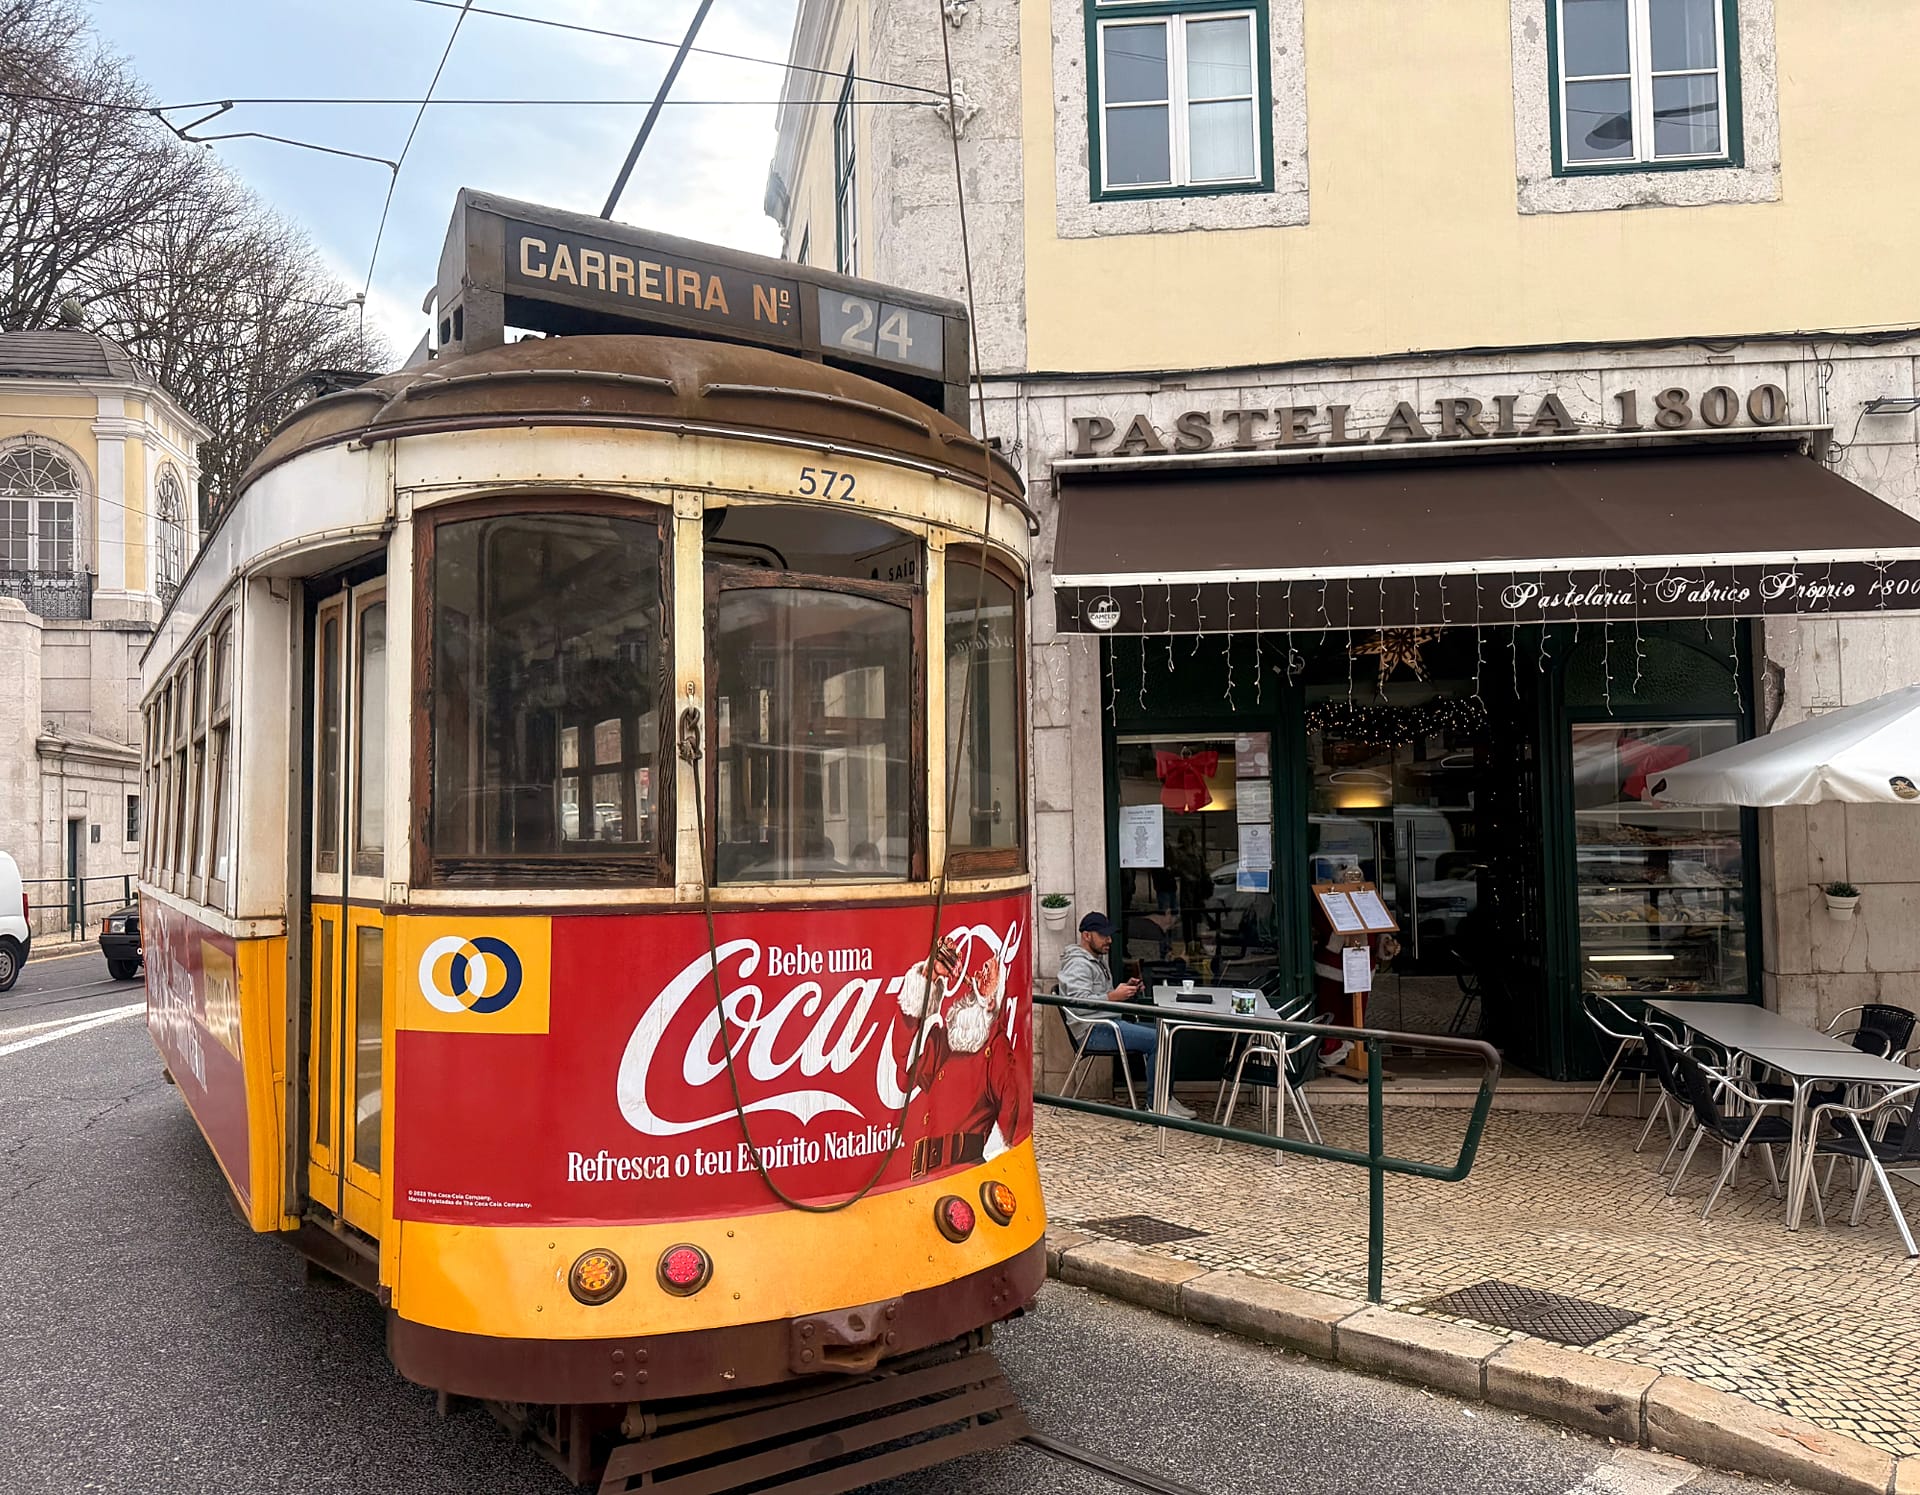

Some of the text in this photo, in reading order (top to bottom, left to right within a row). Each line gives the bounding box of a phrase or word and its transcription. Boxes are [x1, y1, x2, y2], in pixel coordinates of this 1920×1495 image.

[520, 236, 729, 315] CARREIRA
[840, 297, 913, 359] 24
[1073, 383, 1787, 457] PASTELARIA 1800
[798, 466, 857, 501] 572
[888, 556, 916, 582] SAÍD
[768, 944, 873, 977] Bebe uma
[567, 1151, 670, 1182] Refresca
[675, 1153, 690, 1177] o
[694, 1147, 732, 1176] teu
[737, 1137, 820, 1173] Espírito
